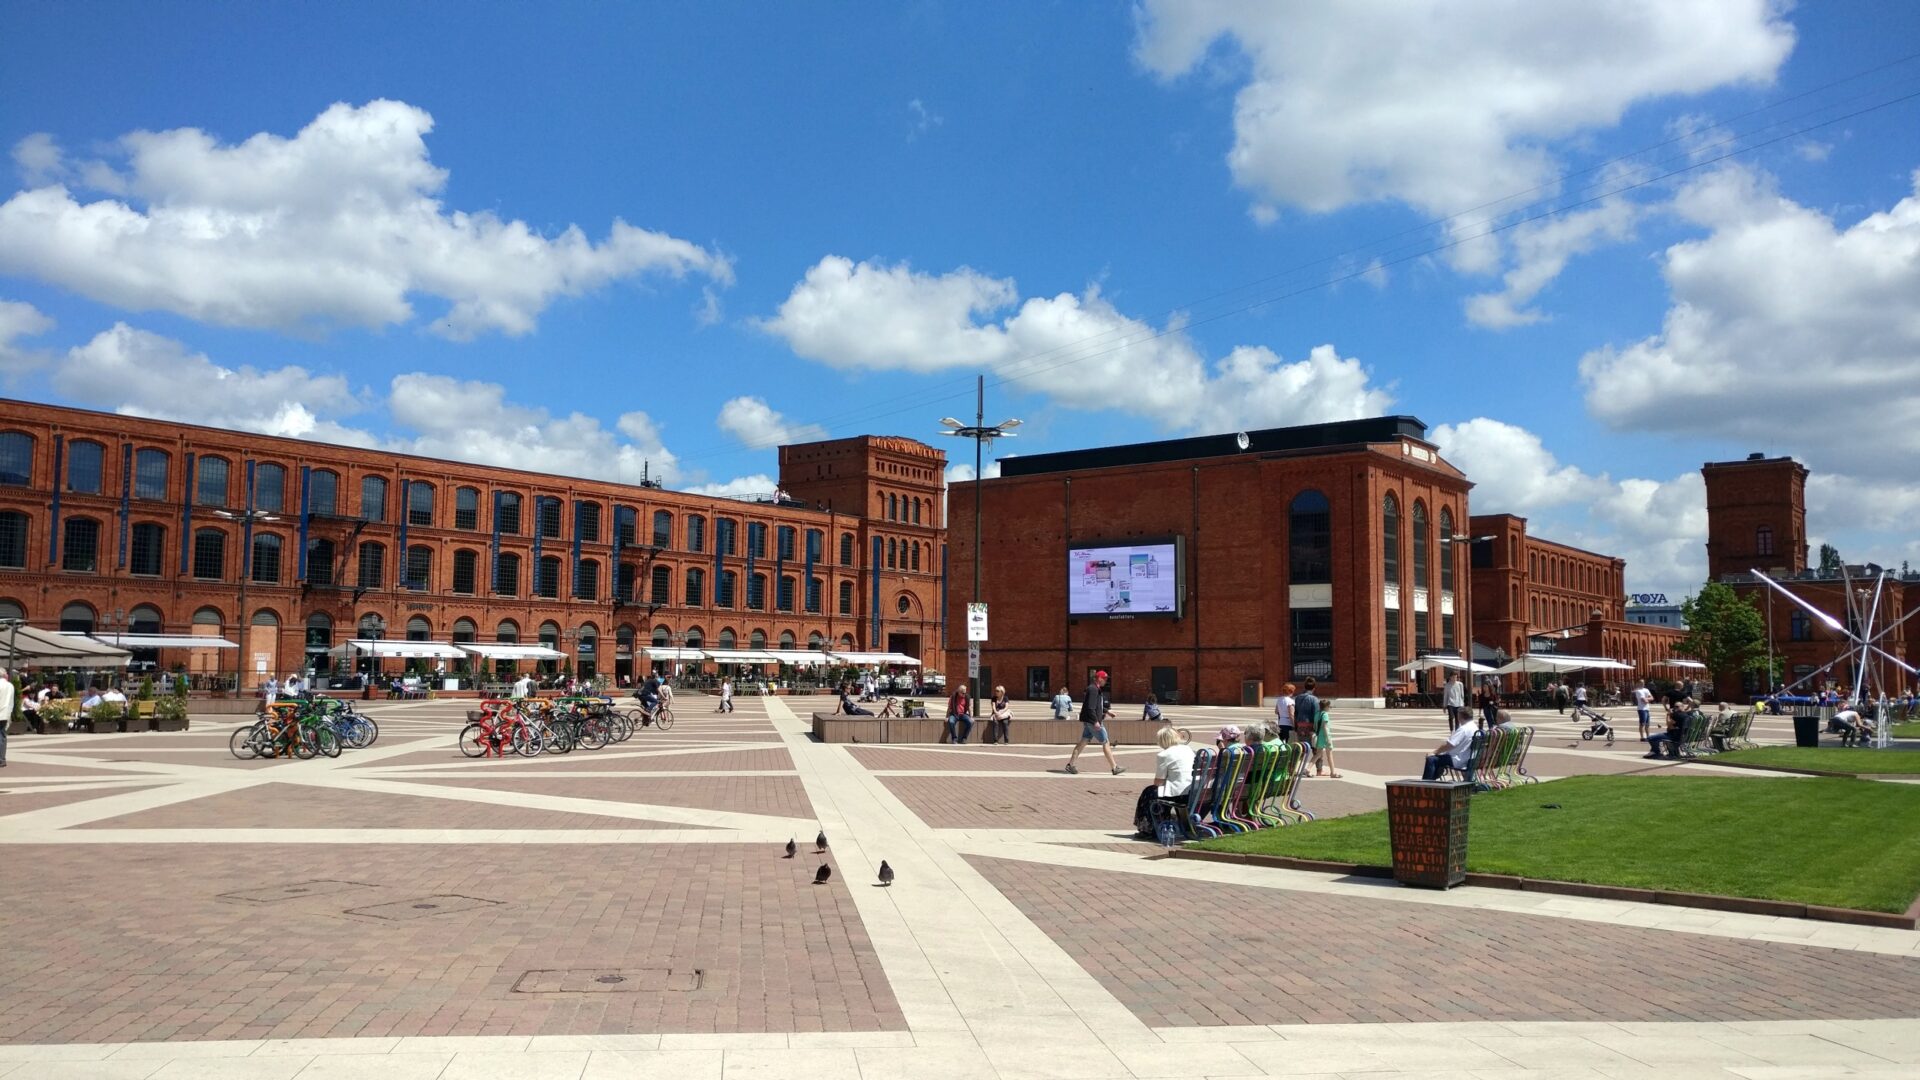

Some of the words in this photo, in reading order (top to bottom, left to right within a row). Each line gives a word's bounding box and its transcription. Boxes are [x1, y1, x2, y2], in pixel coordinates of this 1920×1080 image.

[876, 438, 914, 453] CINEMA
[916, 446, 939, 458] CITY
[1632, 594, 1668, 603] TOYA
